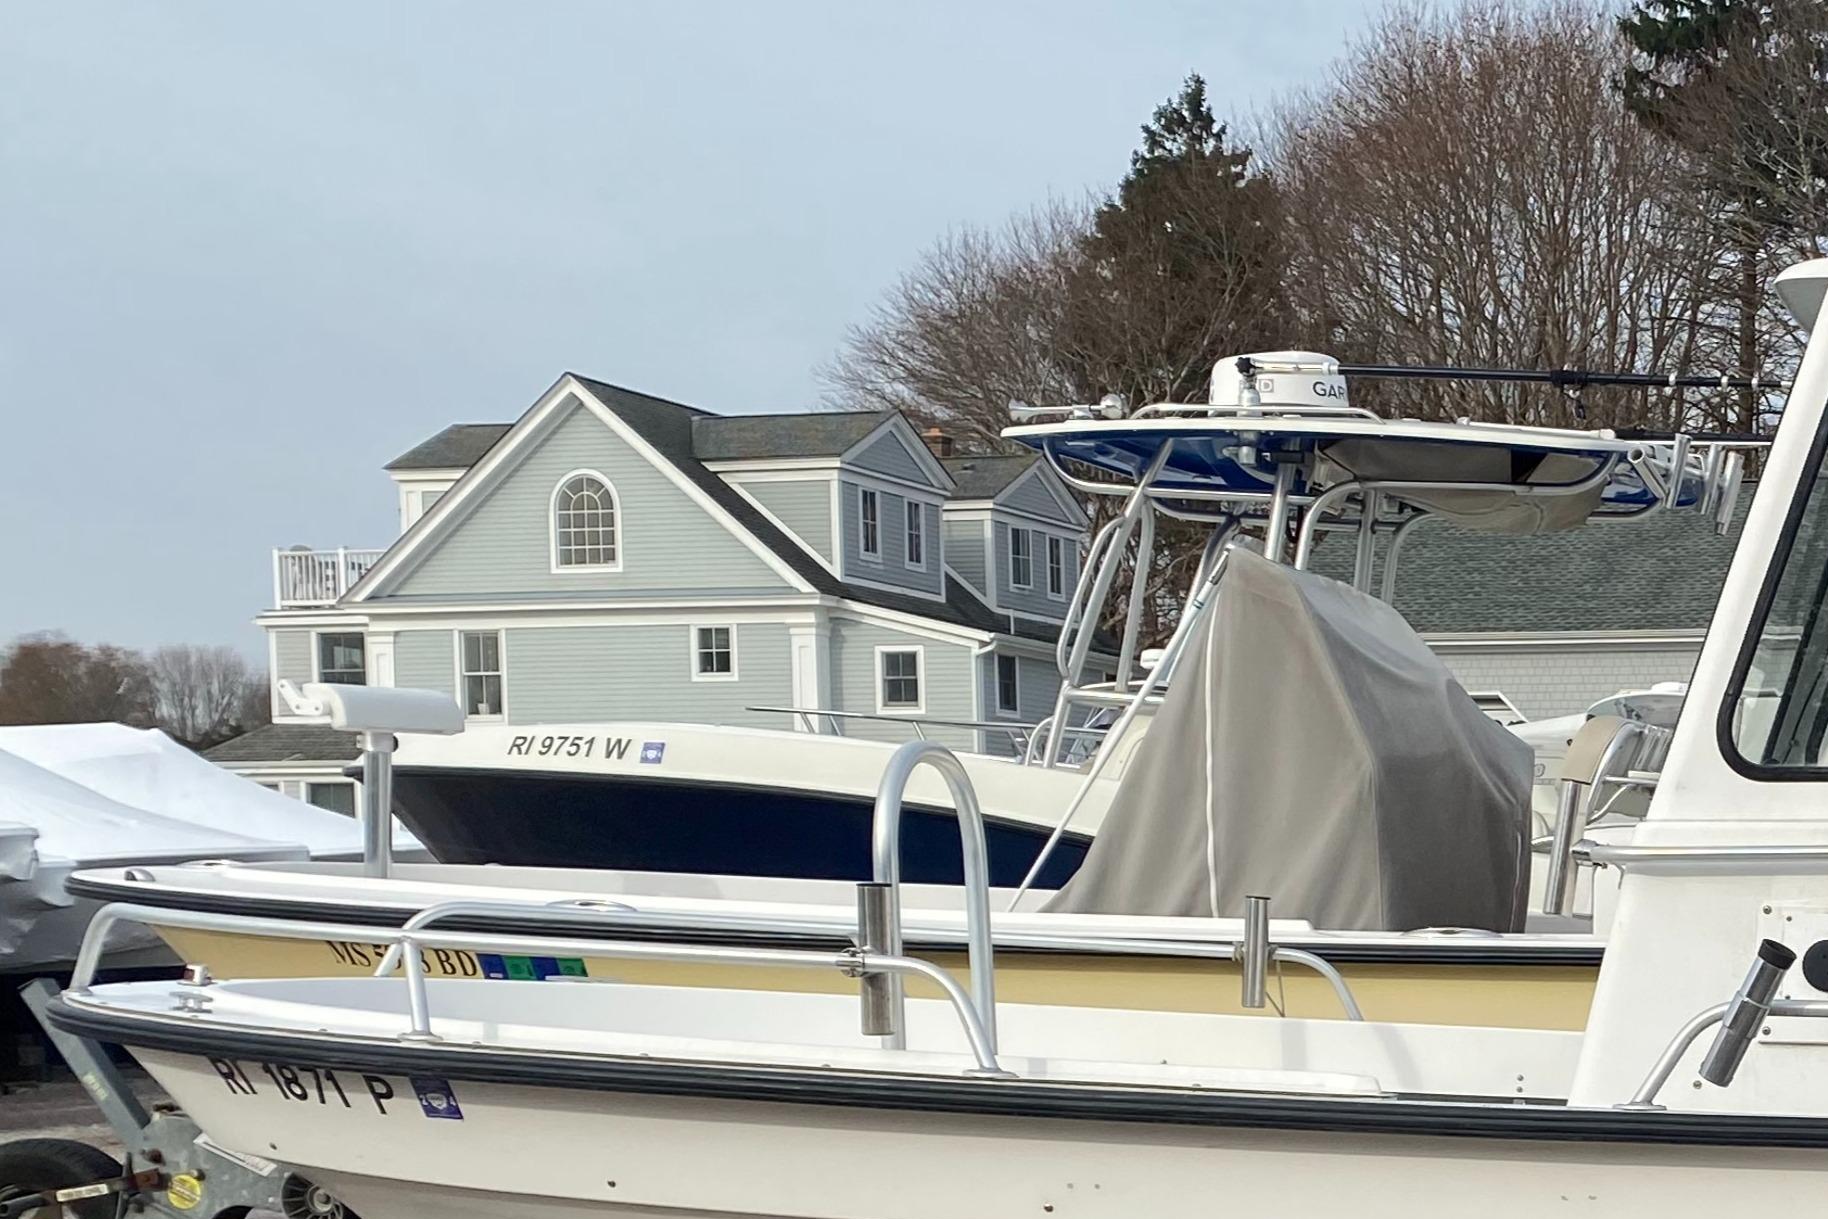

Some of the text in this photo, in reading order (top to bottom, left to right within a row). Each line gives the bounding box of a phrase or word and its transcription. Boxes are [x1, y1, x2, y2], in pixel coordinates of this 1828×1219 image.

[507, 736, 535, 756] RI
[538, 736, 595, 757] 9751
[604, 737, 632, 760] W
[328, 941, 371, 968] MS
[434, 948, 478, 977] BD
[208, 1056, 394, 1115] RI 1871 P
